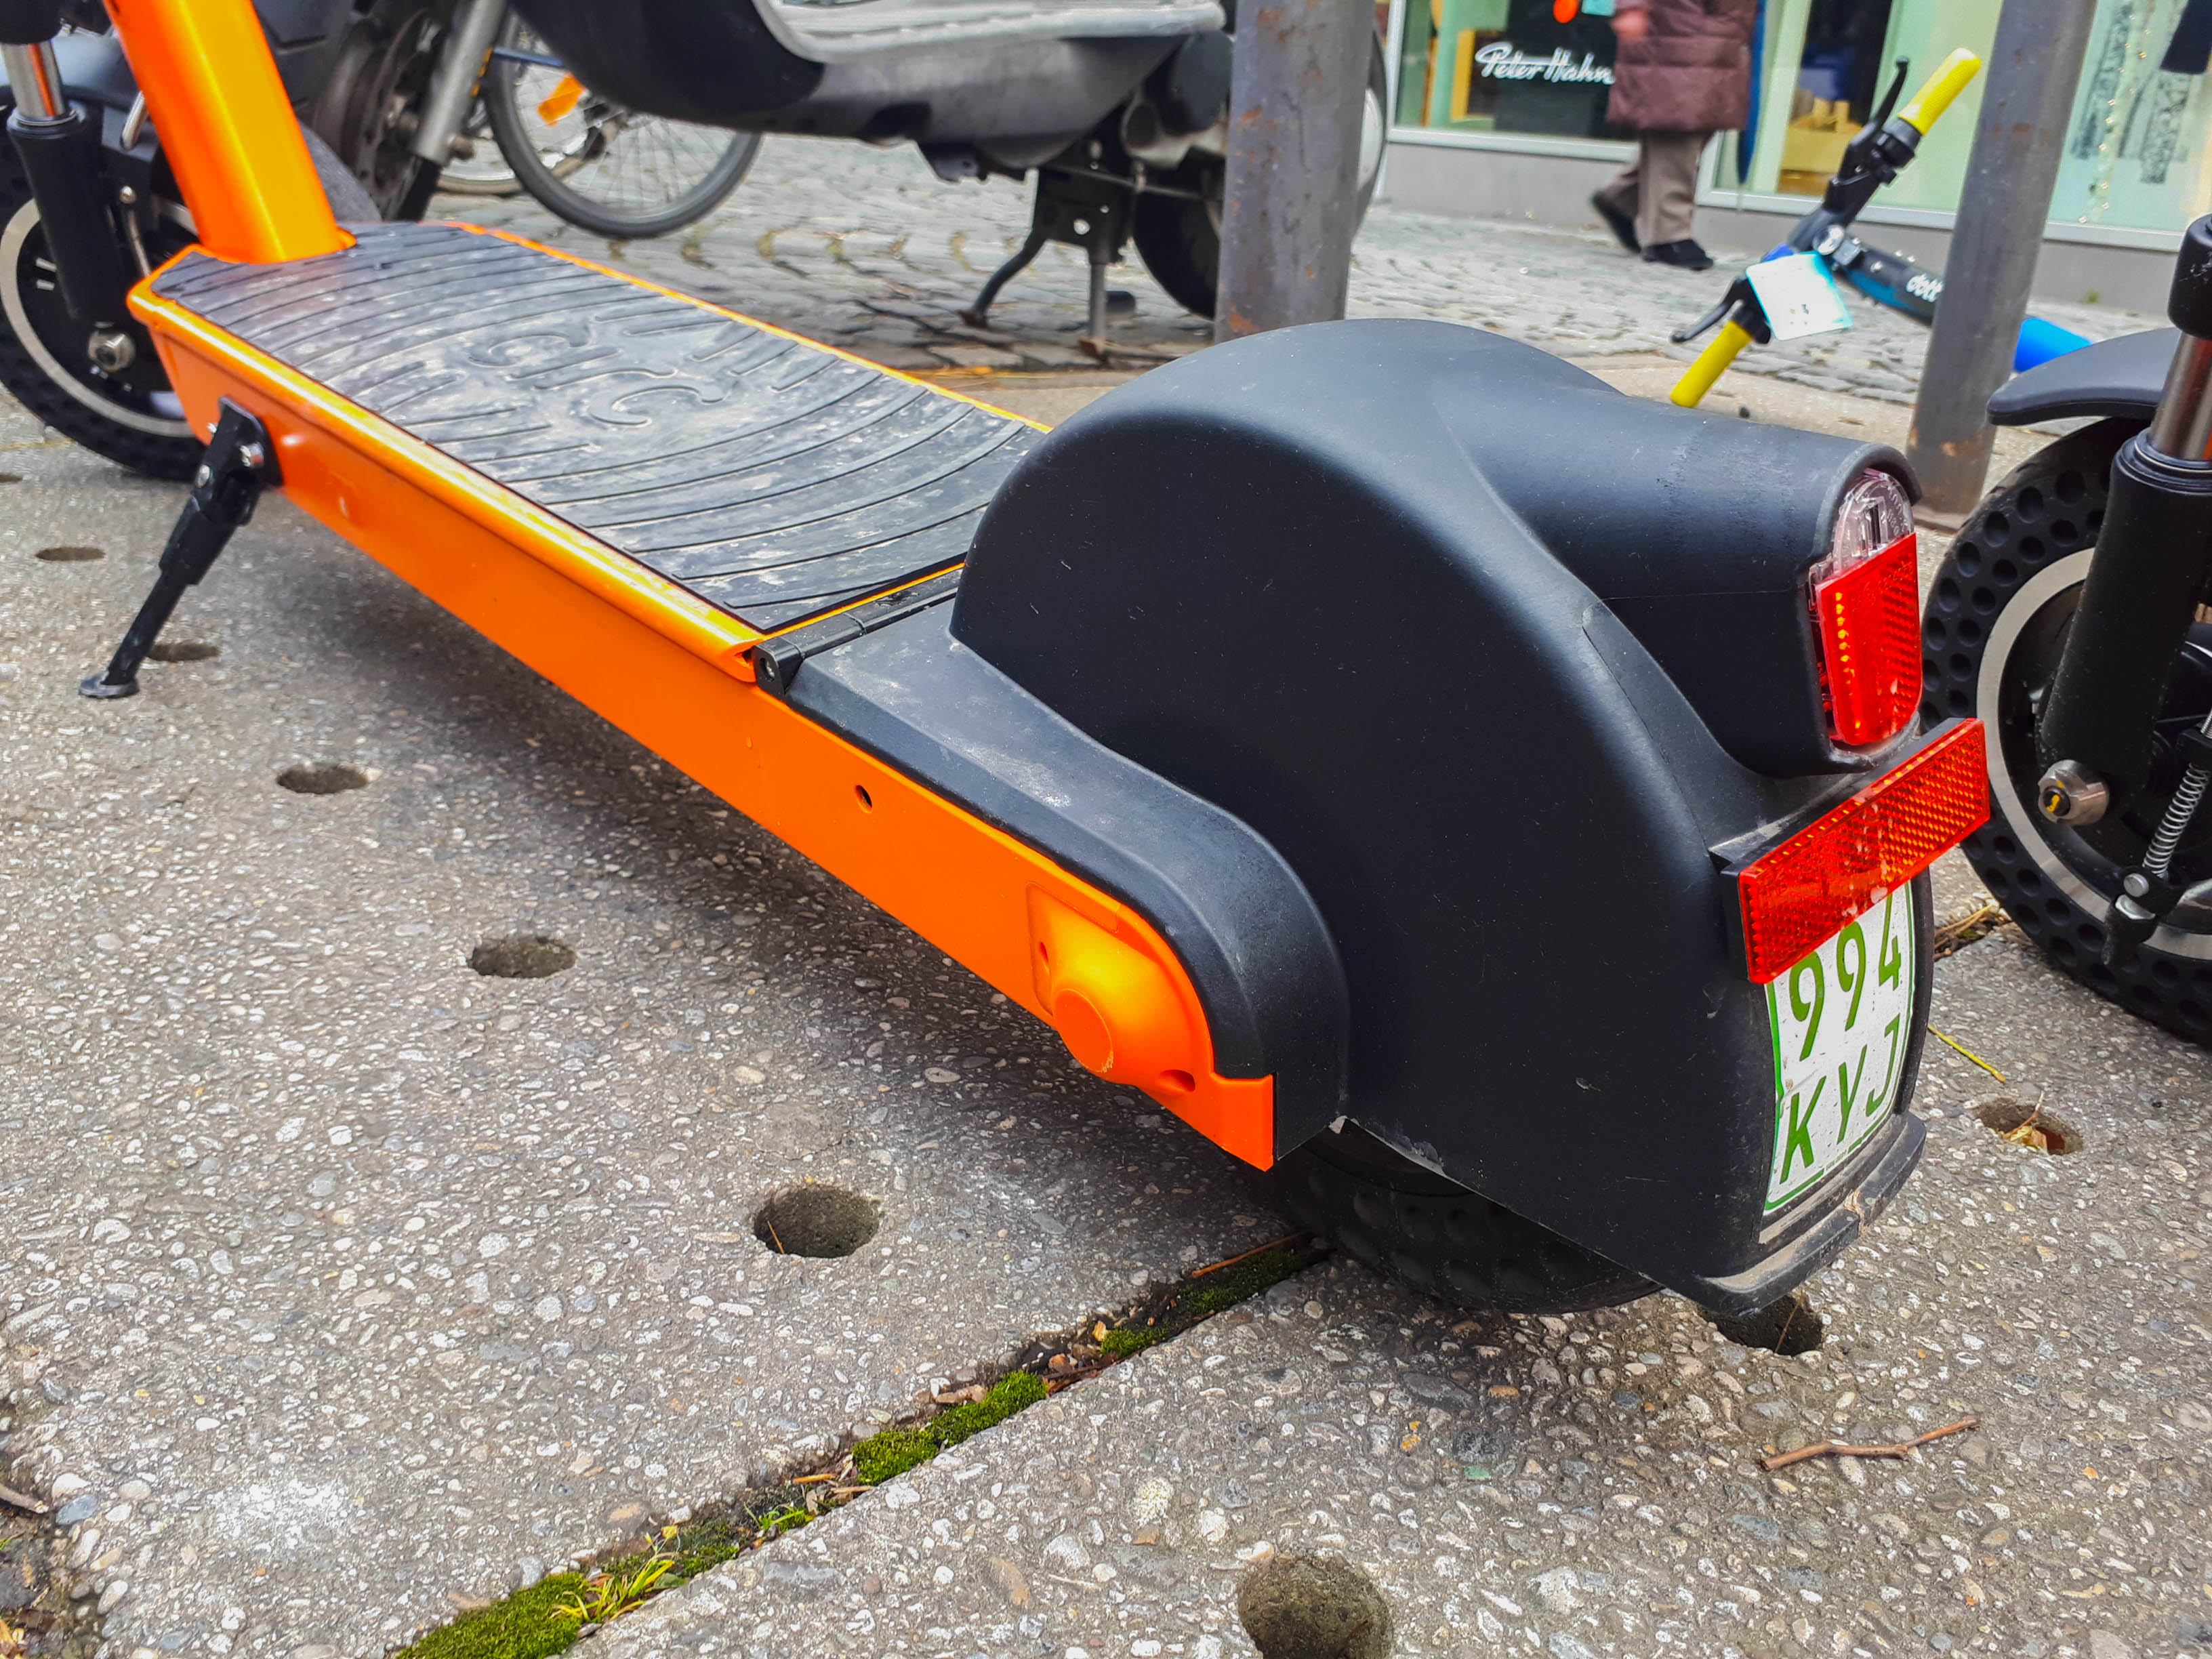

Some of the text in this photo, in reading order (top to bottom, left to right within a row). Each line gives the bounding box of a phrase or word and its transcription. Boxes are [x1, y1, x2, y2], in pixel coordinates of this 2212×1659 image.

[1475, 41, 1616, 85] Peter Hahn
[1789, 894, 1902, 1061] 994
[1780, 1012, 1900, 1185] KYJ
